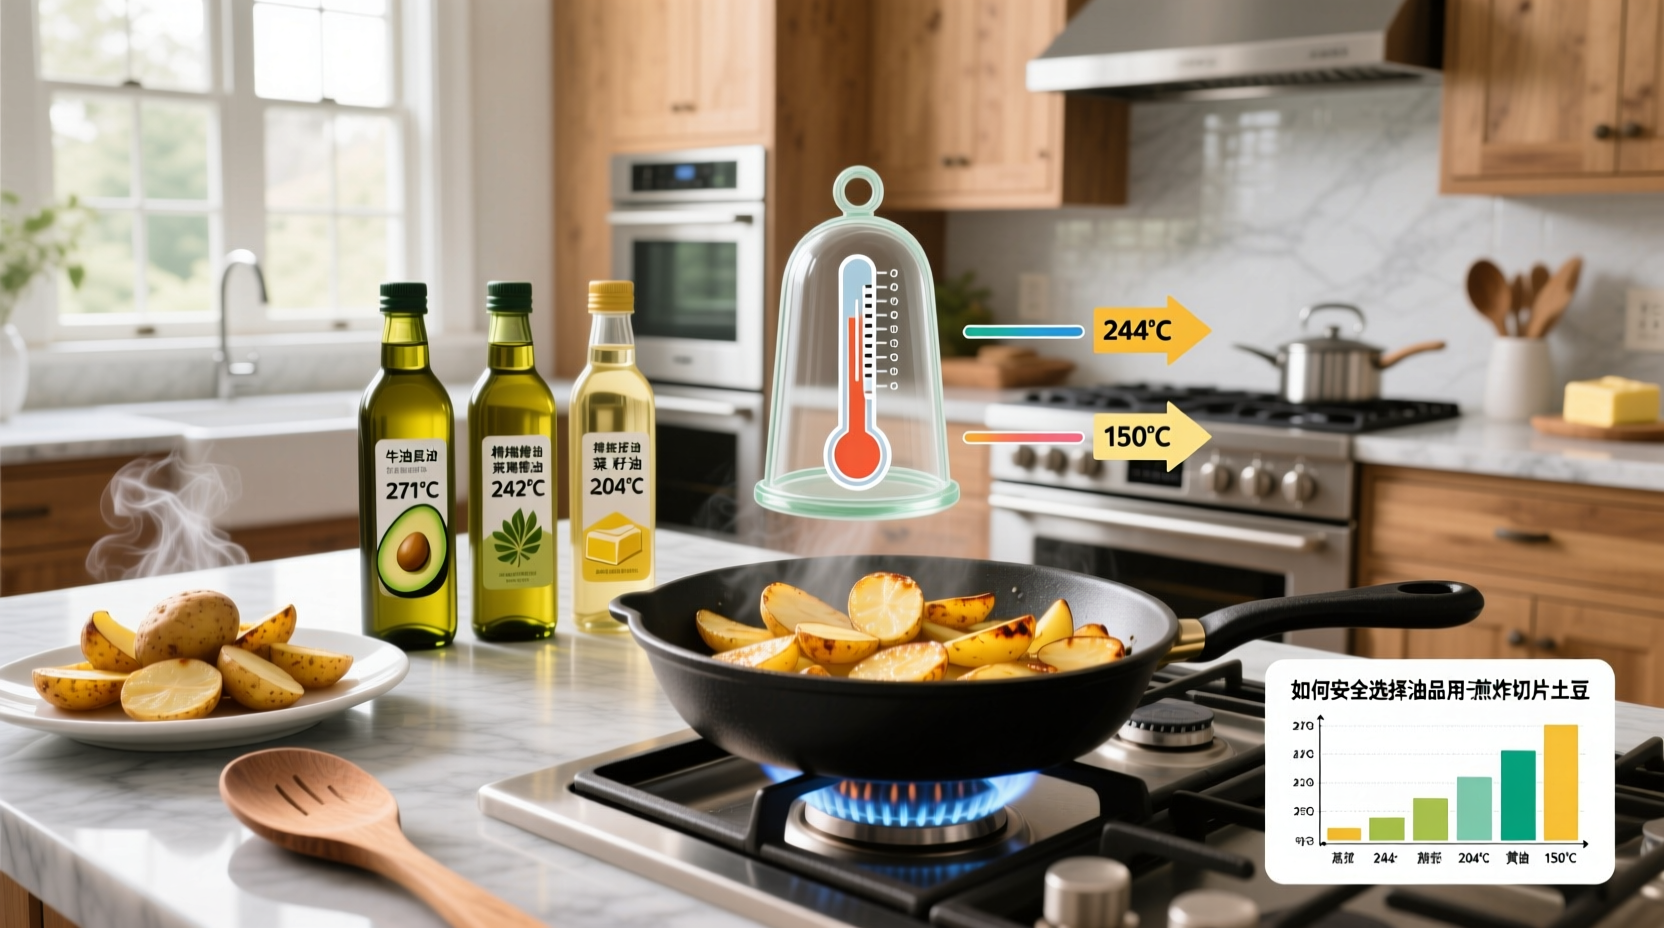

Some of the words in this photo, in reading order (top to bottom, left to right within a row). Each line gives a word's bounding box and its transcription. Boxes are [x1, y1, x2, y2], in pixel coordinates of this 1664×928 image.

[386, 481, 439, 500] 271°C
[491, 478, 546, 498] 242°C
[590, 476, 644, 496] 204°C
